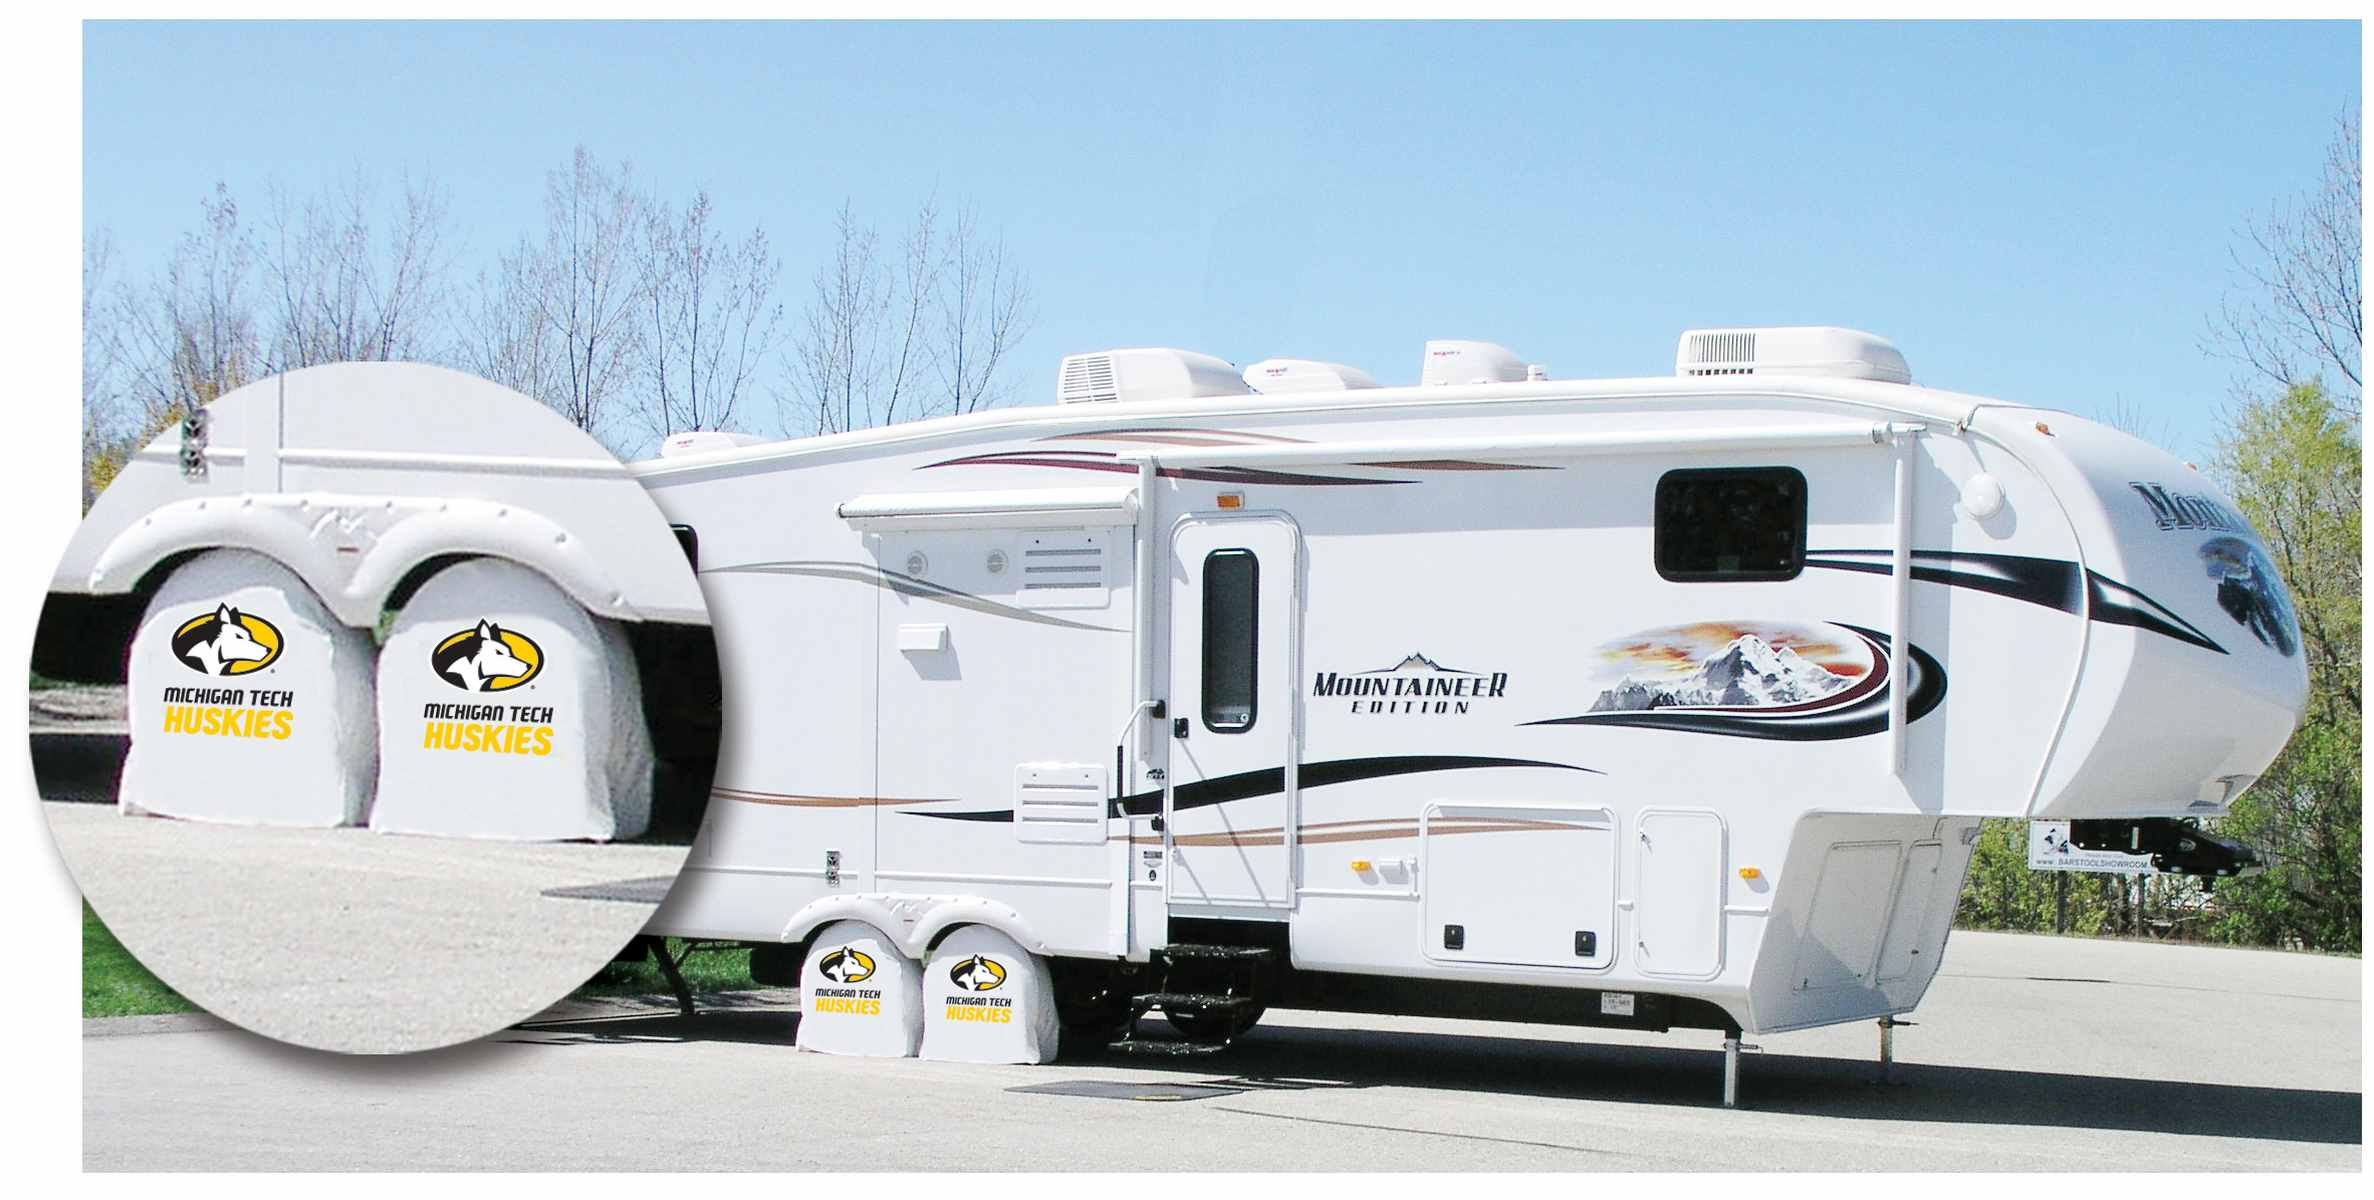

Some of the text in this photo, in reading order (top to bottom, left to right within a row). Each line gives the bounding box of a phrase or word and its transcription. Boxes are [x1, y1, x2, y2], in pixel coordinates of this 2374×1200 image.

[1313, 672, 1508, 698] MOUNTAINEER
[163, 686, 294, 708] MICHIGAN TECH
[423, 703, 554, 724] MICHIGAN TECH
[1351, 700, 1470, 715] EDITION
[163, 705, 295, 741] HUSKIES
[423, 720, 555, 757] HUSKIES
[815, 988, 881, 999] MICHIGAN TECH
[945, 996, 1012, 1007] MICHIGAN TECH
[815, 997, 881, 1016] HUSKIES
[946, 1006, 1012, 1024] HUSKIES
